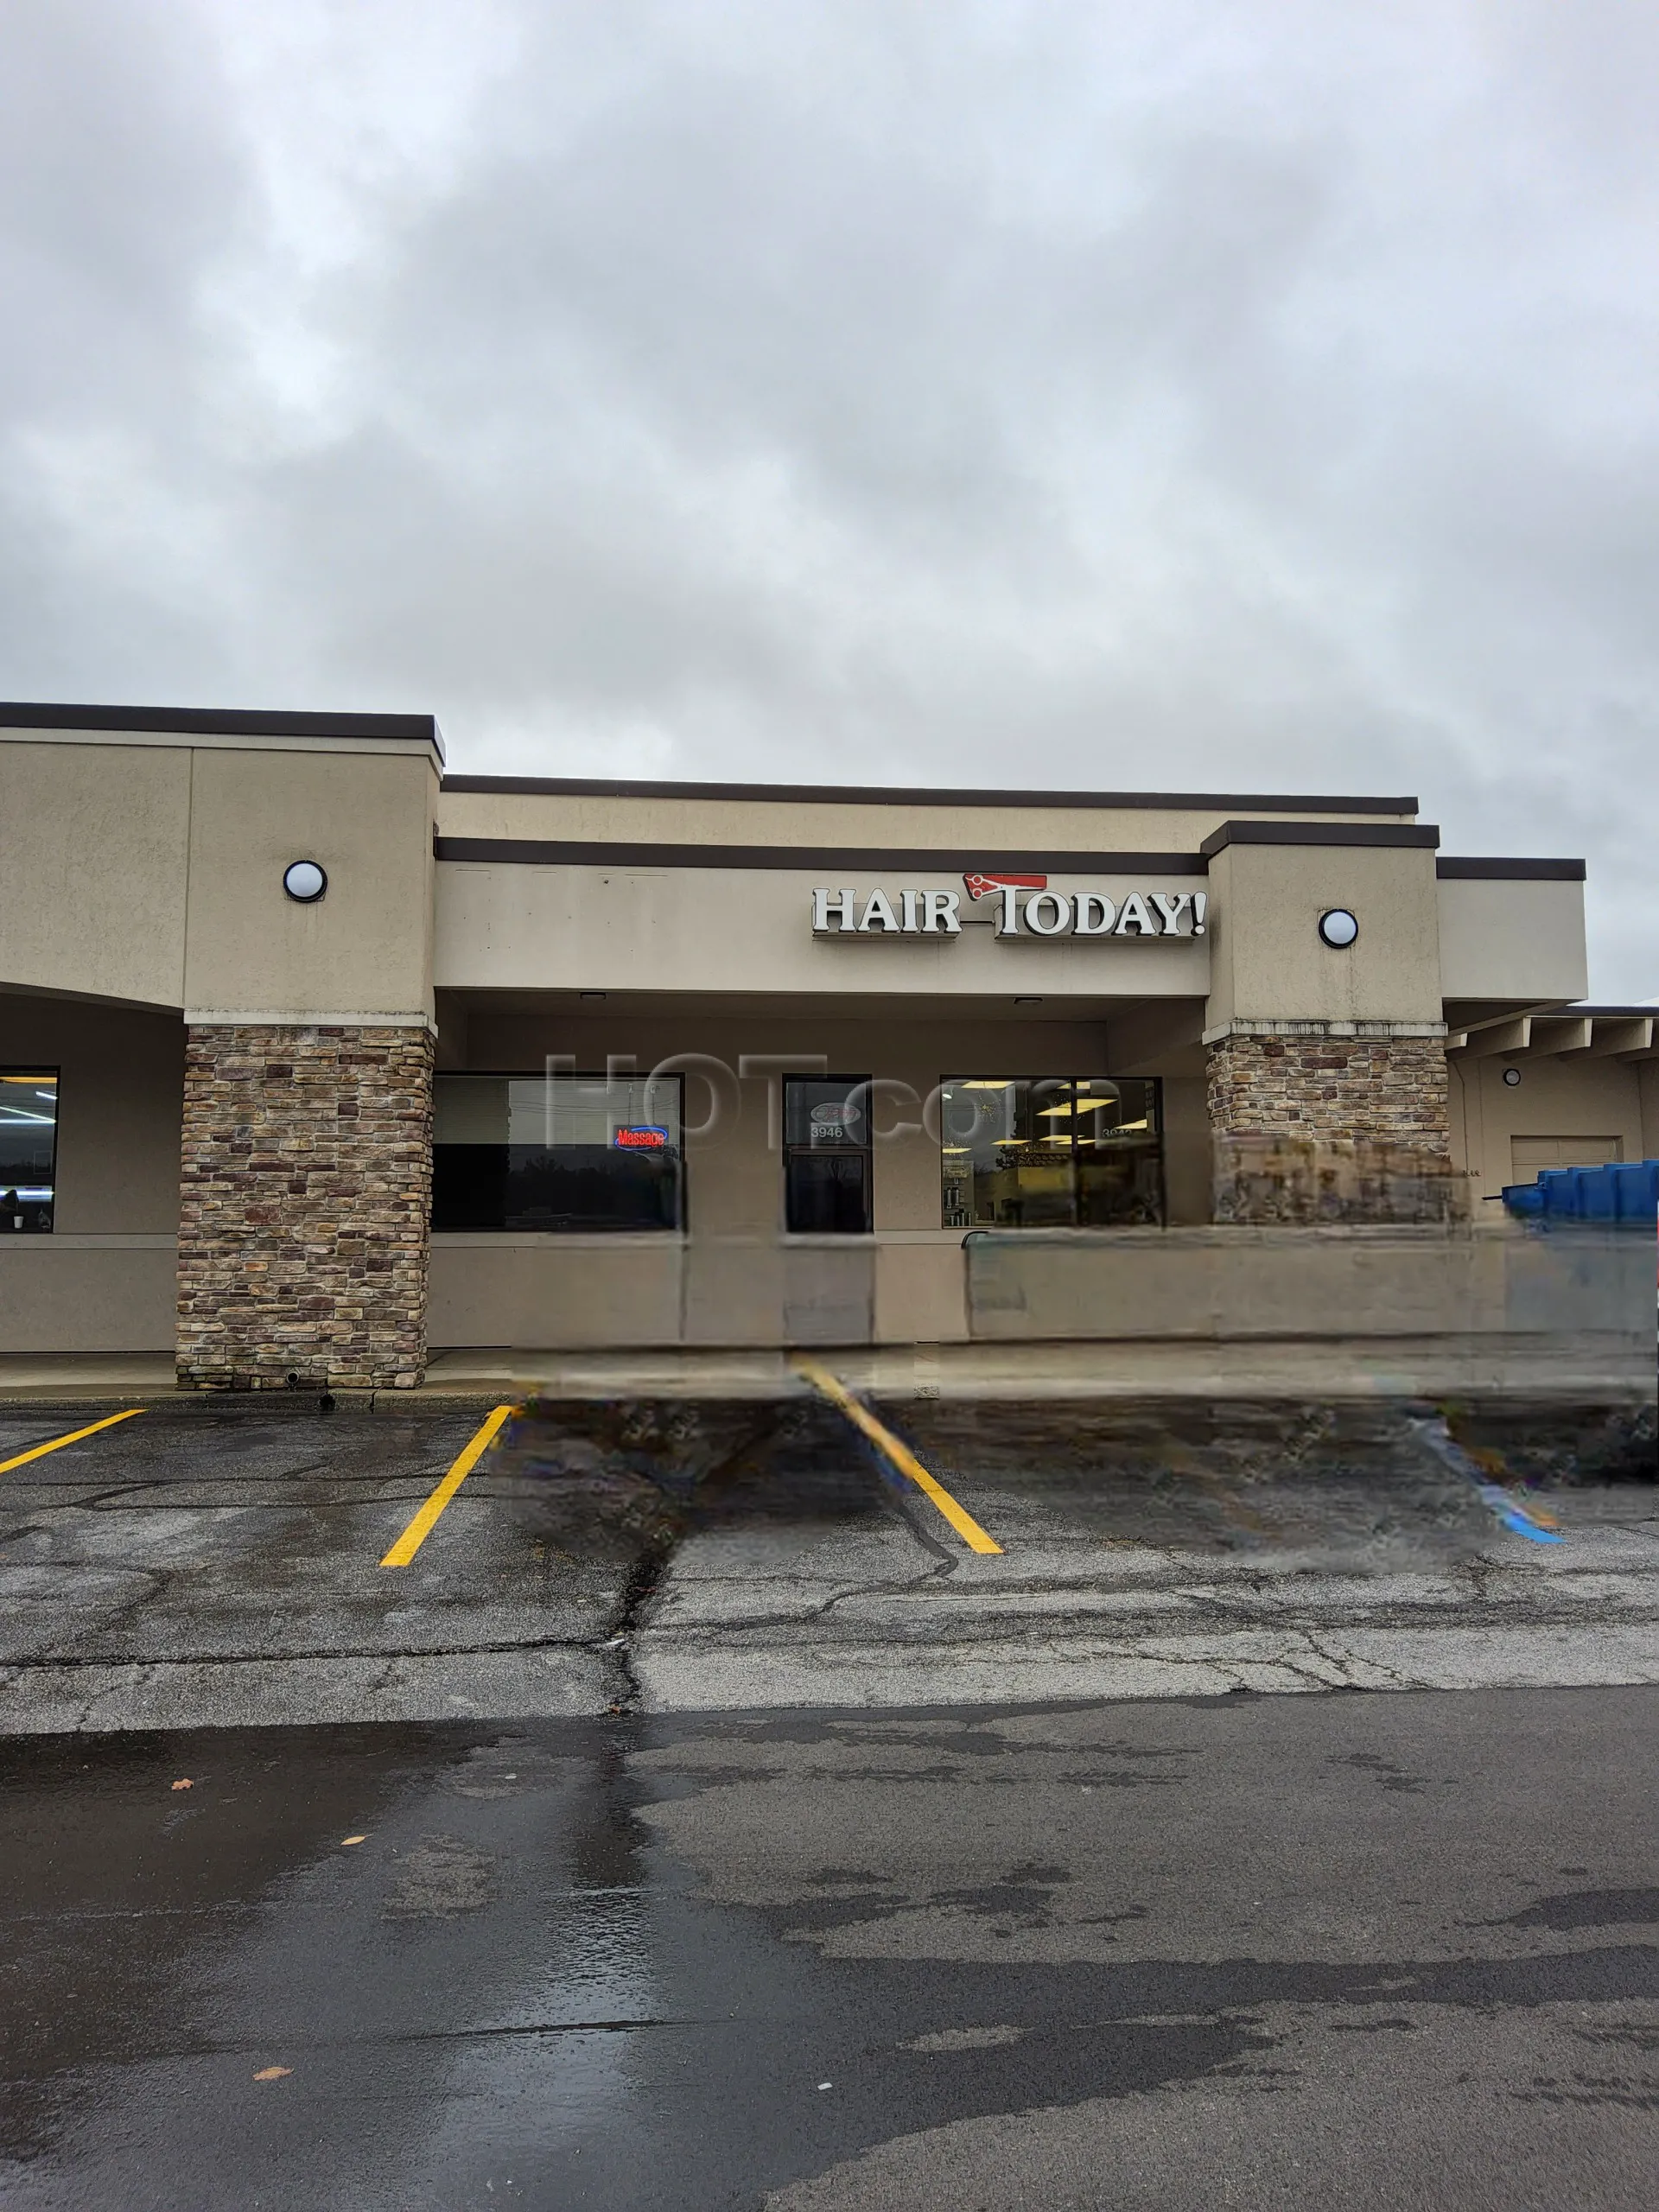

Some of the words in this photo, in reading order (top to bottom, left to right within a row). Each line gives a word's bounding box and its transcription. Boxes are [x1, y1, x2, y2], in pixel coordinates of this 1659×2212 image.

[812, 887, 962, 934] HAIR
[994, 885, 1208, 937] TODAY!
[618, 1128, 664, 1147] Massage
[811, 1126, 843, 1138] 3946
